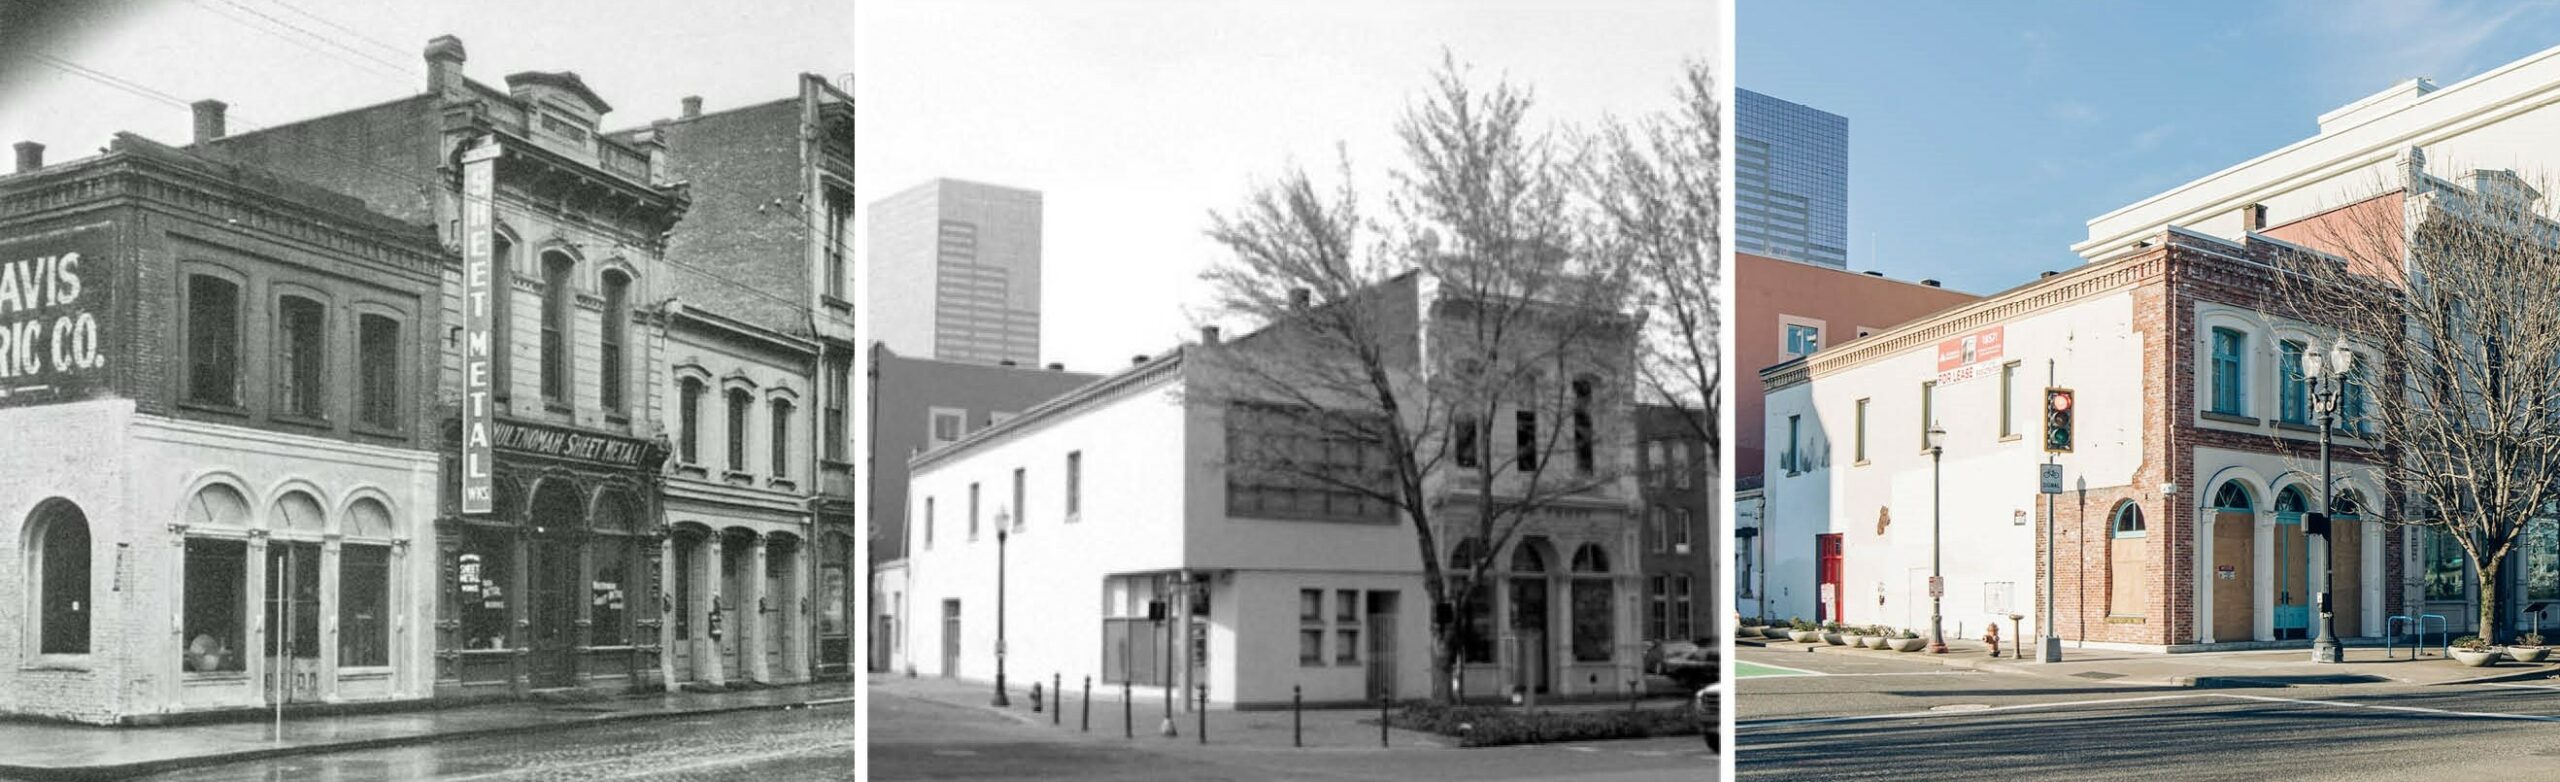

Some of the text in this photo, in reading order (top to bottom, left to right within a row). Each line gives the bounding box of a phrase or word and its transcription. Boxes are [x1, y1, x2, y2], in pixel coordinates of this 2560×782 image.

[0, 252, 82, 315] AVIS
[51, 312, 105, 373] CO.
[468, 170, 489, 479] SHEET METAL
[1938, 372, 1951, 384] FOR
[1952, 366, 1974, 382] LEASE
[564, 433, 606, 461] SHEET
[602, 439, 641, 465] METAL
